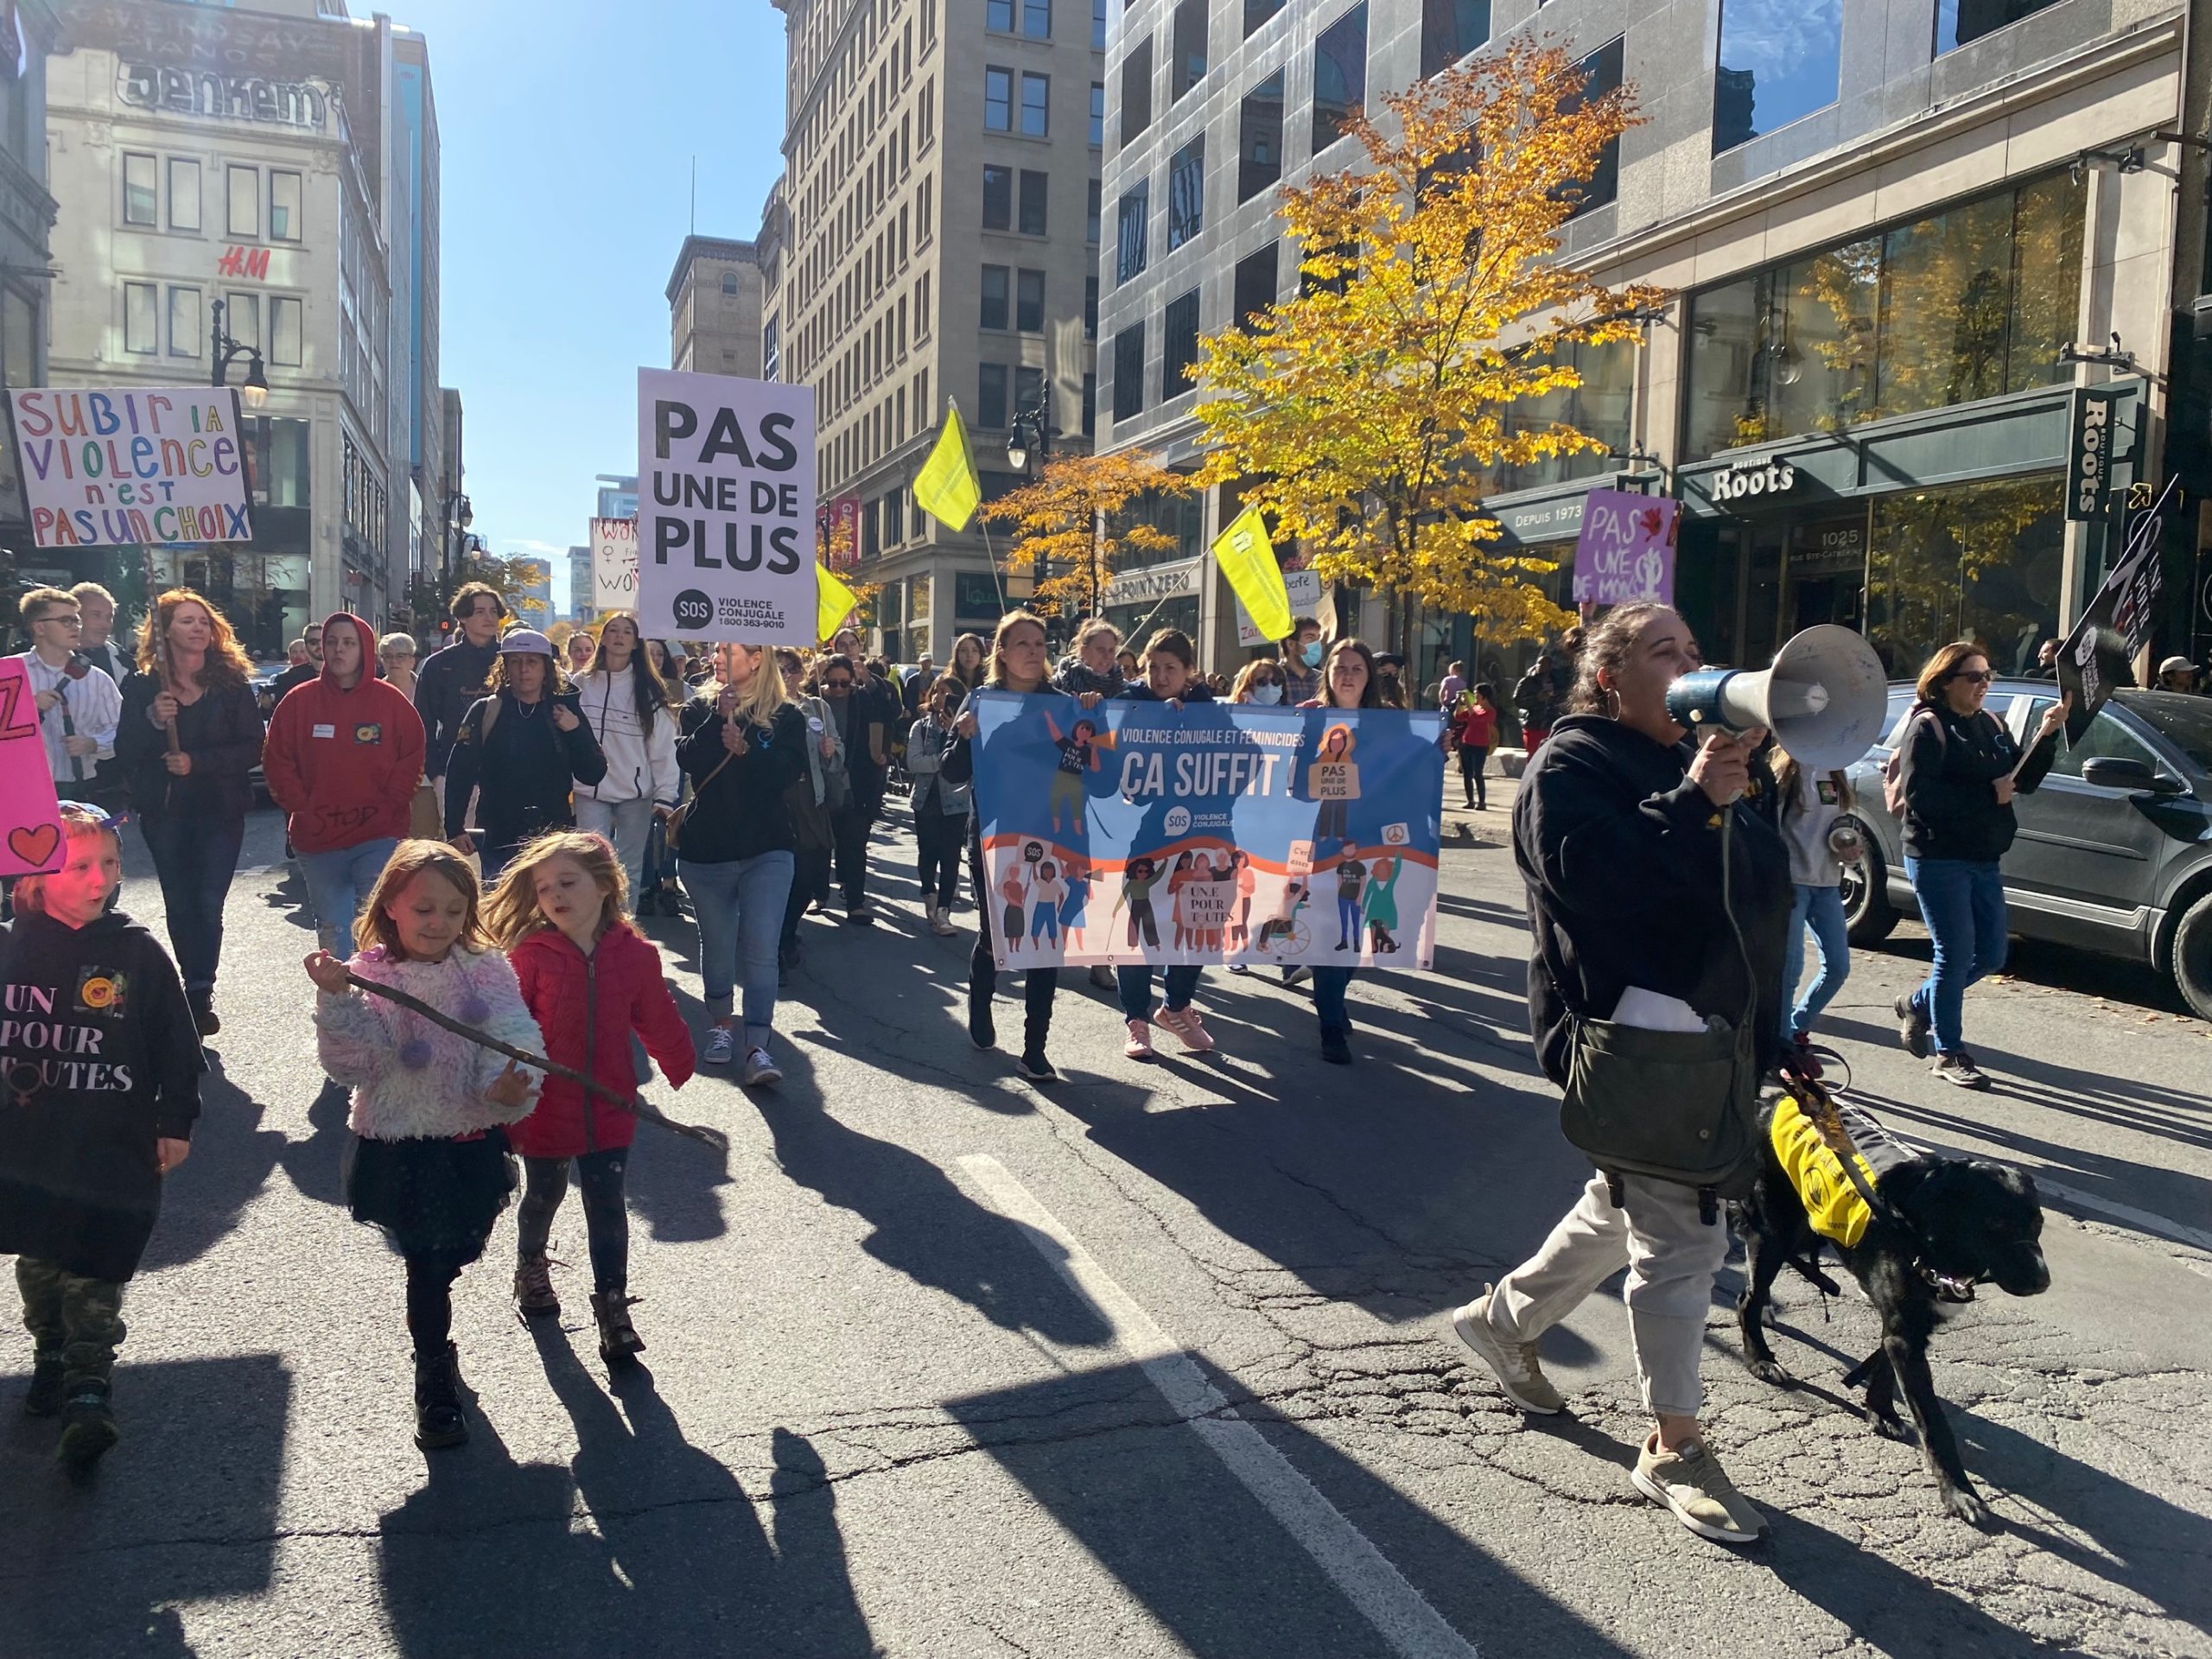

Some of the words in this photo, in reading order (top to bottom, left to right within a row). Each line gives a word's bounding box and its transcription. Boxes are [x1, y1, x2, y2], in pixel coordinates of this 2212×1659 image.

[218, 246, 270, 281] H&M
[655, 399, 798, 472] PAS
[1732, 456, 1772, 470] BOUTIQUE
[2079, 398, 2107, 512] Roots
[2097, 428, 2107, 480] BOUTIQUE
[1711, 462, 1795, 502] Roots
[653, 470, 736, 512] UNE
[750, 480, 798, 518] DE
[32, 506, 98, 546] PAS
[153, 503, 249, 542] CHOIX
[1555, 505, 1582, 521] 1973
[1587, 505, 1642, 545] PAS
[655, 516, 801, 575] PLUS
[1821, 529, 1859, 547] 1025
[1594, 546, 1634, 575] UNE
[1156, 571, 1190, 594] ZERO
[1573, 574, 1593, 598] DE
[679, 601, 708, 619] SOS
[718, 597, 773, 610] VIOLENCE
[718, 607, 785, 620] CONJUGALE
[743, 618, 785, 629] 363-9010
[1122, 728, 1172, 744] VIOLENCE
[1174, 730, 1223, 745] CONJUGALE
[1224, 730, 1236, 745] ET
[1239, 728, 1306, 747] FÉMINICIDES
[1120, 751, 1165, 804] ÇA
[1173, 752, 1281, 797] SUFFIT
[1321, 766, 1346, 777] PAS
[1320, 786, 1347, 796] PLUS
[1168, 815, 1188, 827] SOS
[1192, 819, 1235, 828] CONJUGALE
[1027, 847, 1041, 857] SOS
[1190, 899, 1224, 910] POUR
[5, 983, 58, 1014] UN
[0, 1020, 104, 1055] POUR
